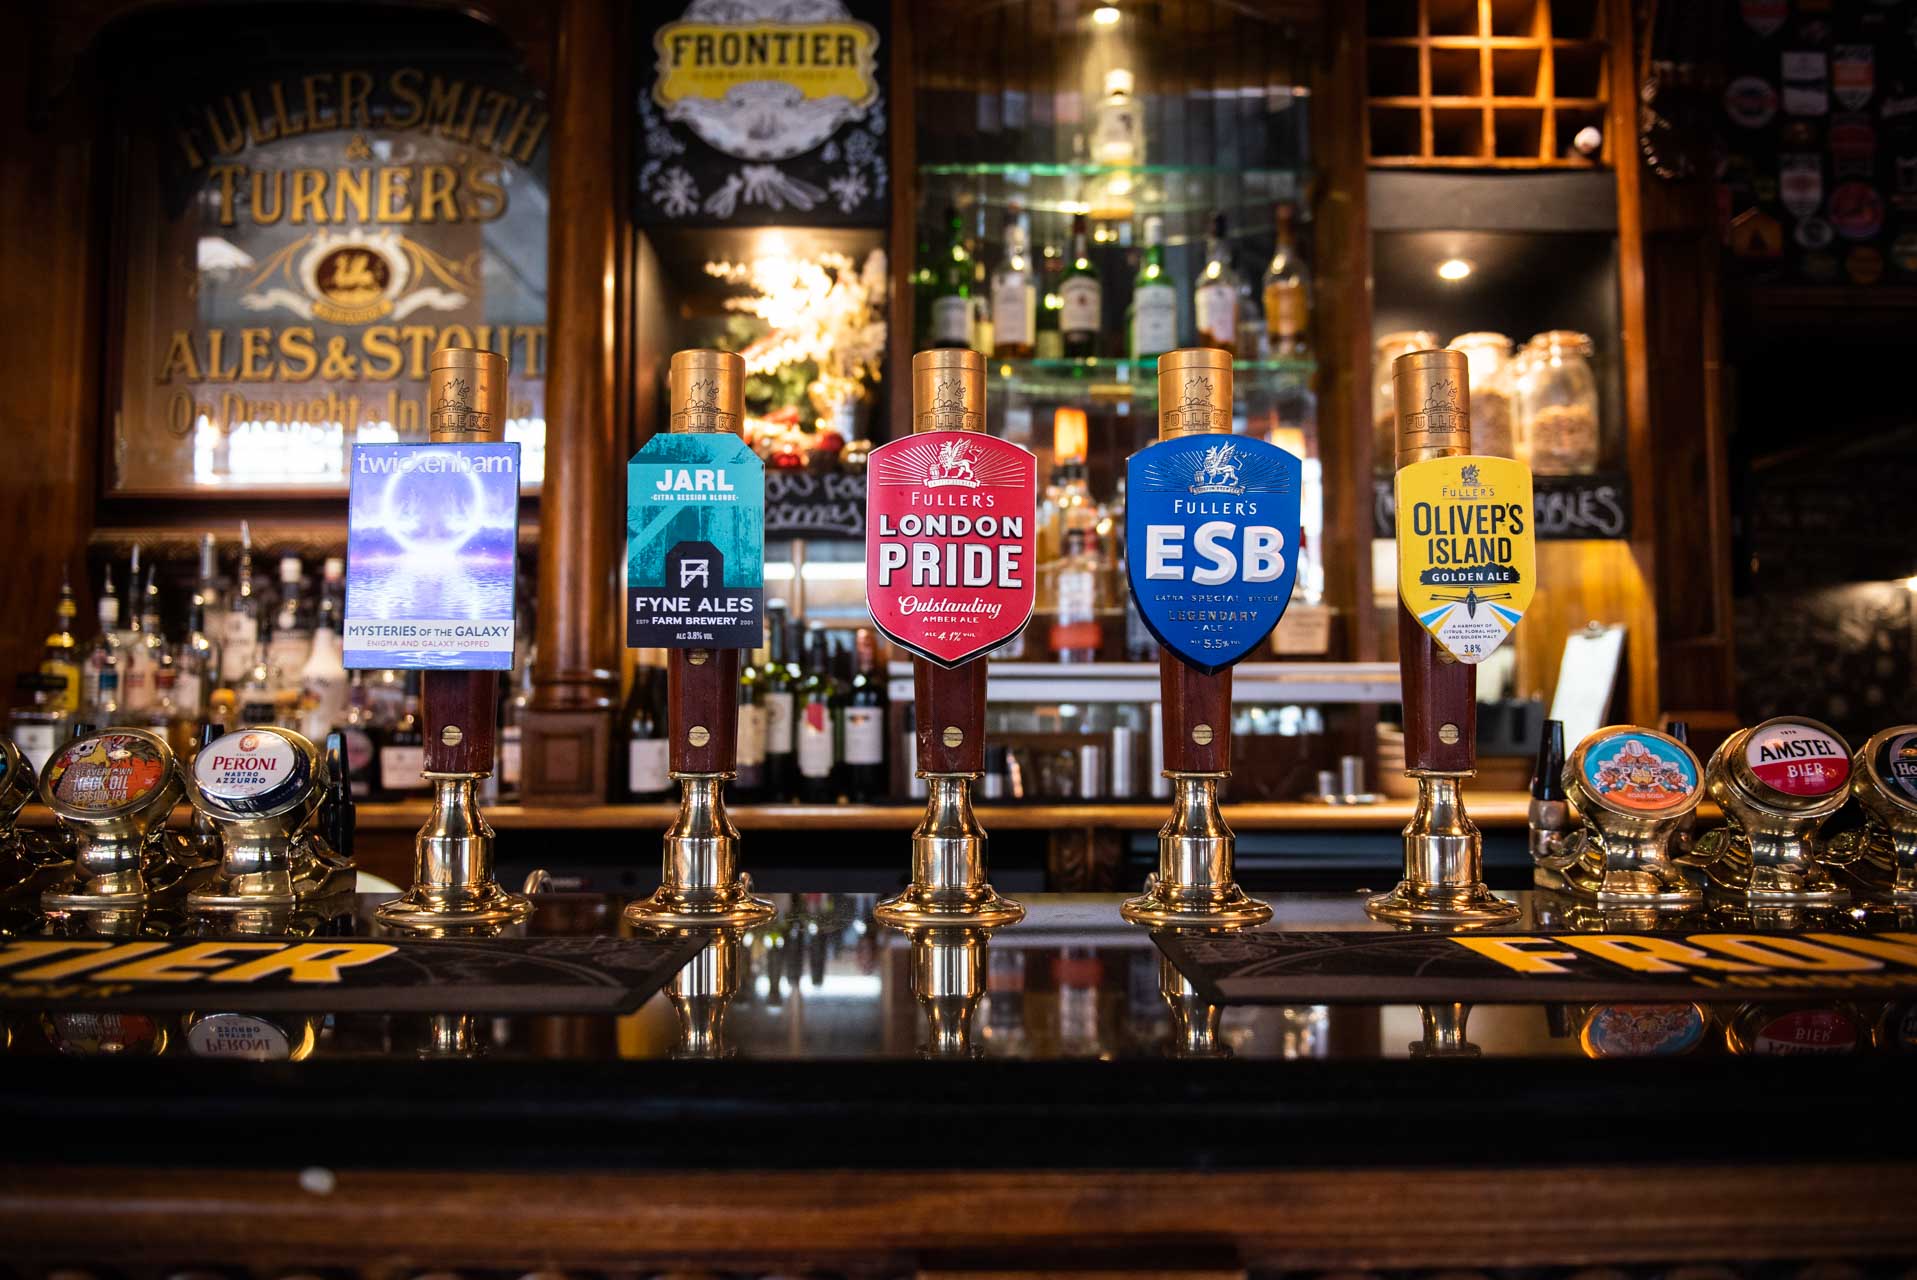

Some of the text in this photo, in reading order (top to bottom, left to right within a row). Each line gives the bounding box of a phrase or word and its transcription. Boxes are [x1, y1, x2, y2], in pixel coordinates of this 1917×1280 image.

[671, 31, 858, 67] FRONTIER
[384, 68, 549, 162] SMITH
[209, 155, 509, 227] TURNER'S
[358, 451, 513, 474] twickenham
[656, 469, 734, 491] JARL
[911, 491, 995, 508] FULLER'S
[1174, 499, 1257, 516] FULLER'S
[879, 513, 1024, 538] LONDON
[1145, 520, 1286, 586] ESB
[1428, 537, 1512, 565] ISLAND
[879, 542, 1023, 589] PRIDE
[1432, 571, 1510, 582] GOLDEN ALE
[636, 597, 754, 613] FYNE ALES
[1191, 594, 1241, 602] SPECIAL
[898, 595, 1003, 619] Outstanding
[652, 617, 682, 625] FARM
[685, 617, 738, 625] BREWERY
[922, 616, 957, 624] AMBER
[1168, 610, 1258, 622] LEGENDARY
[349, 626, 509, 637] MYSTERIES OF THE GALAXY
[687, 632, 702, 640] 3.8%
[938, 631, 962, 641] 4.1%
[1464, 644, 1481, 653] 3.8%
[1760, 739, 1836, 762] AMSTEL
[212, 756, 277, 771] PERONI
[1787, 762, 1825, 778] BIER
[1621, 766, 1660, 778] PALE
[109, 776, 129, 791] OIL
[72, 790, 128, 802] SESSION IPA
